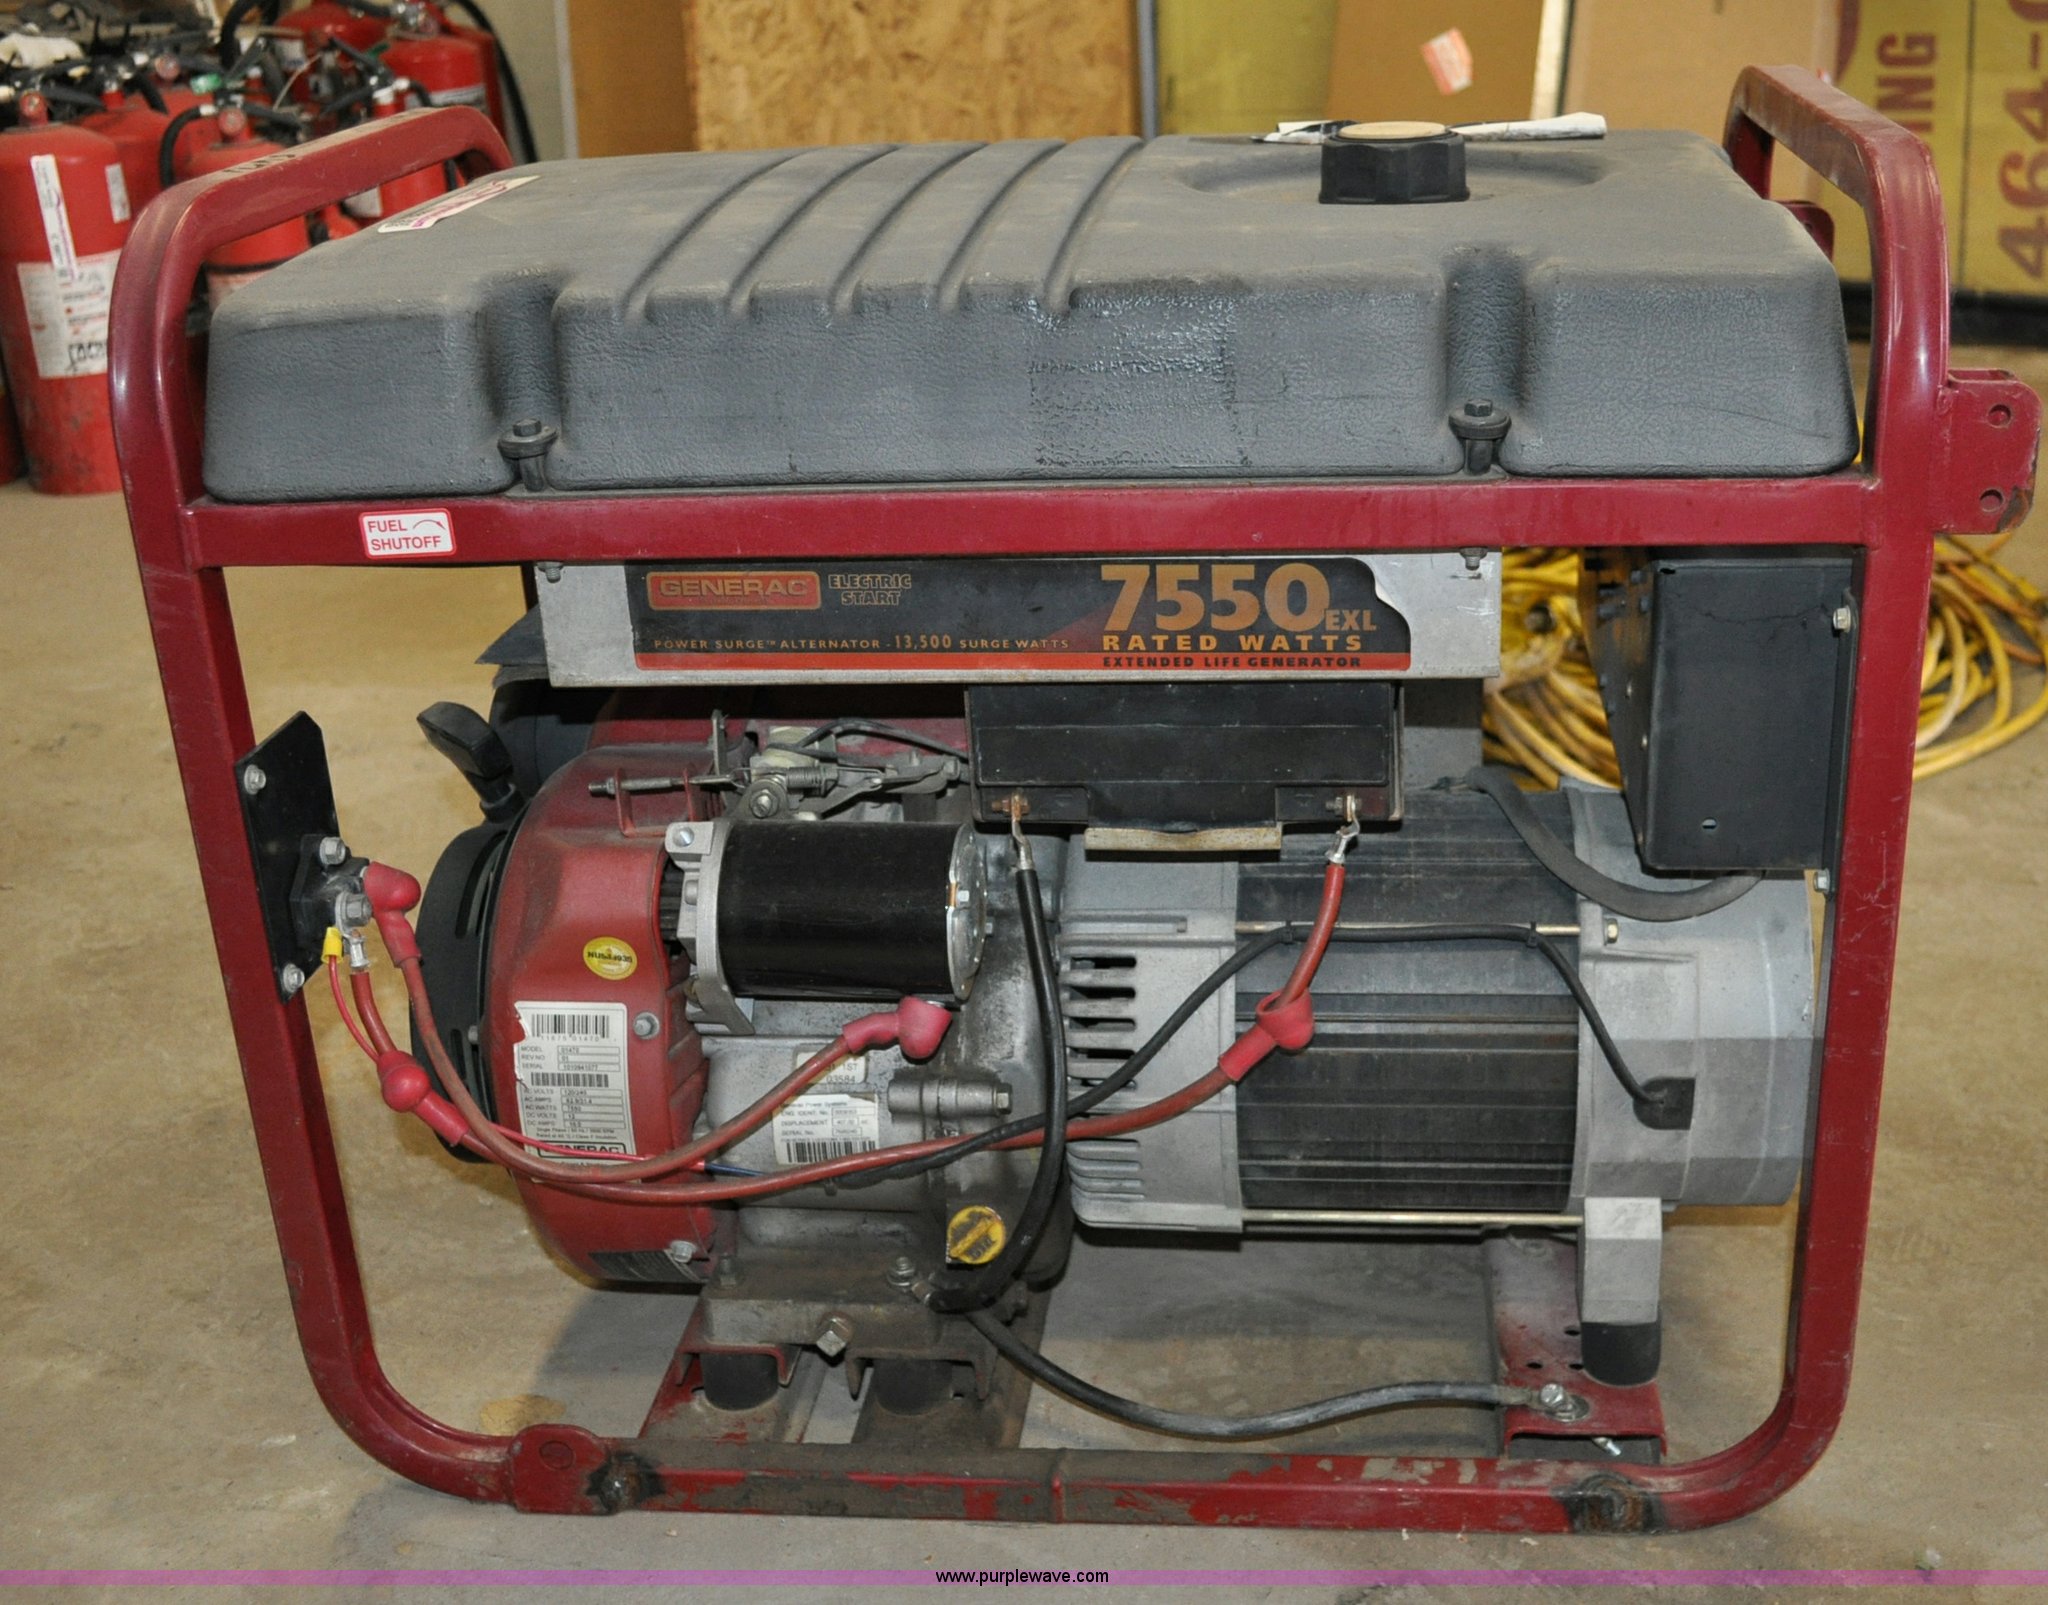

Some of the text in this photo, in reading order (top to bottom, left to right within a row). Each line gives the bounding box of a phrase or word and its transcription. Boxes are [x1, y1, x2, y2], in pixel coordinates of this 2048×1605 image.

[367, 519, 408, 533] FUEL
[371, 535, 442, 551] SHUTOFF
[660, 578, 808, 597] GENERAC
[828, 573, 912, 590] ELECTRIC
[841, 590, 901, 606] START
[1101, 562, 1377, 633] 7550 EXL
[654, 638, 708, 650] POWER
[780, 638, 881, 650] ALTERNATOR
[894, 634, 952, 651] 13,500
[959, 638, 1011, 649] SURGE
[1014, 638, 1070, 650] WATTS
[1102, 634, 1363, 652] RATED WATTS
[1102, 656, 1362, 668] EXTENDED LIFE GENERATOR
